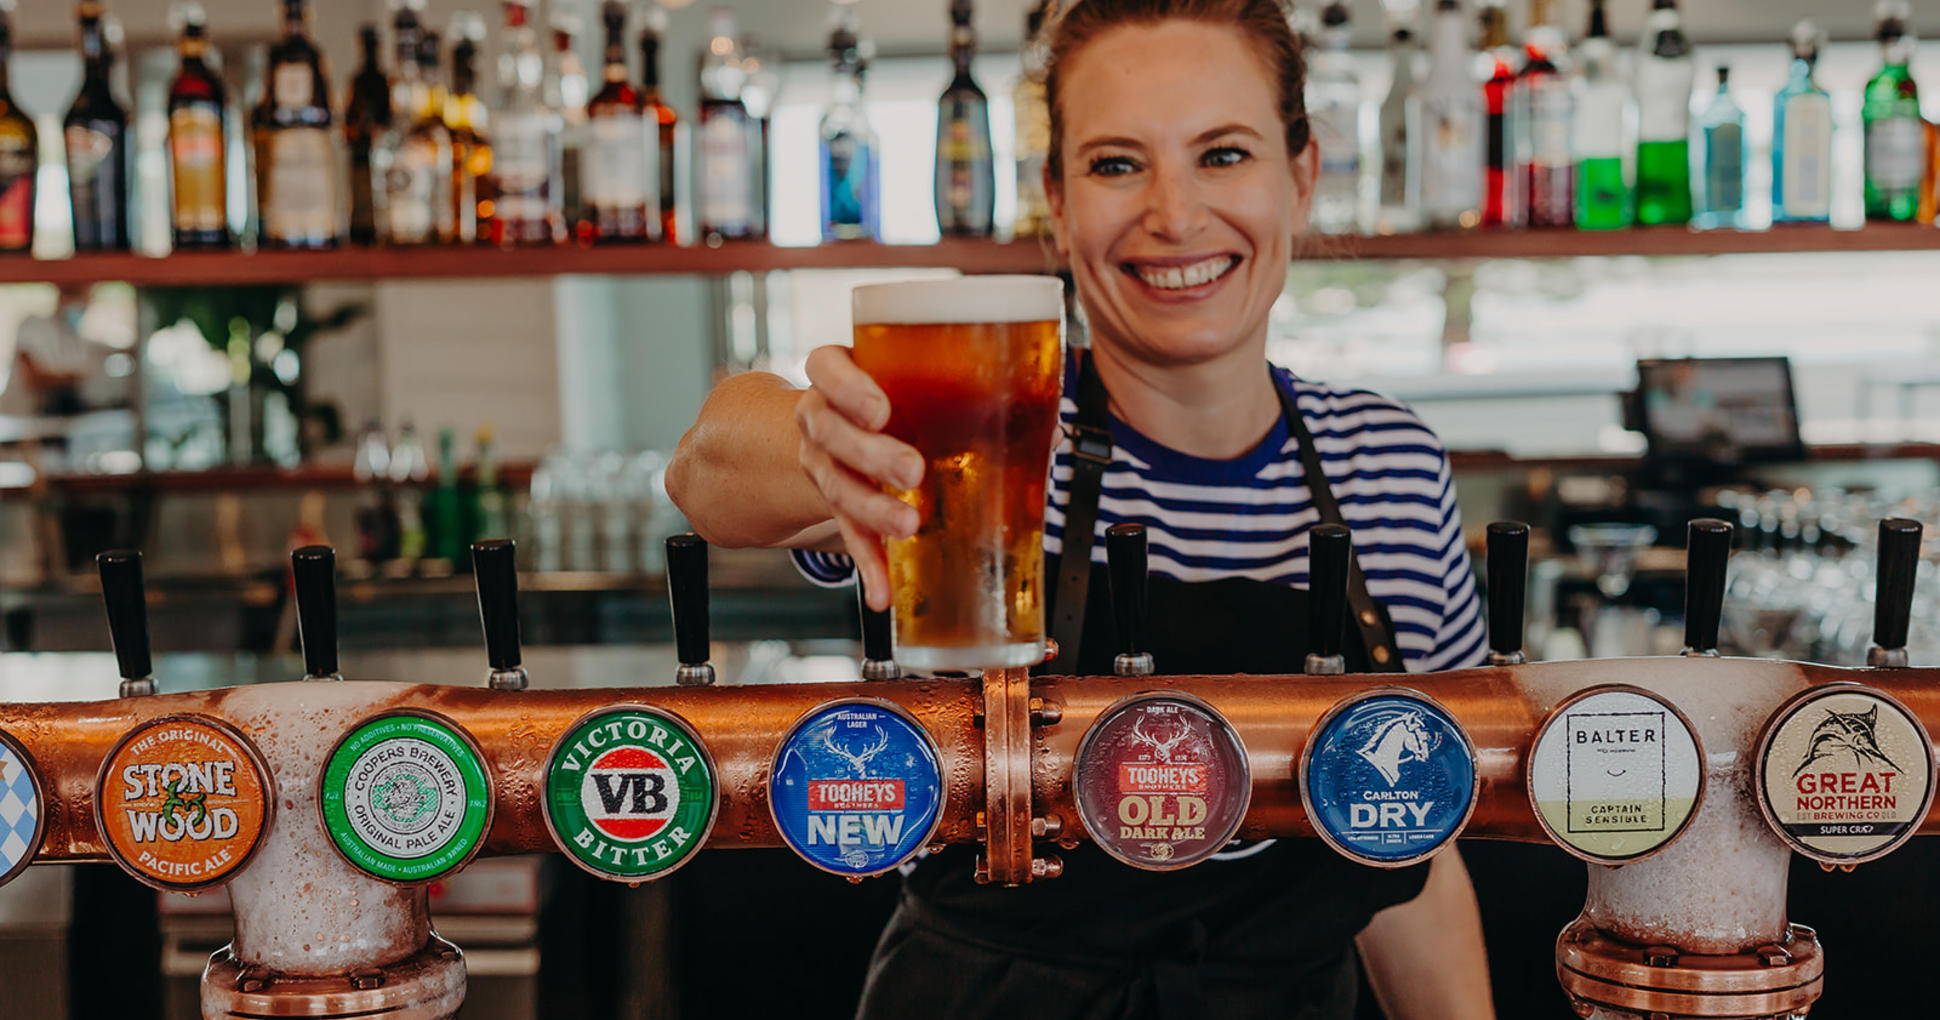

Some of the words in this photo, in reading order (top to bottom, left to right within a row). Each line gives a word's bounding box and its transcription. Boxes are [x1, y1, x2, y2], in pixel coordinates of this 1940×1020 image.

[837, 712, 878, 720] AUSTRALIAN
[1167, 705, 1179, 713] ALE
[130, 735, 156, 756] THE
[158, 729, 225, 754] ORIGINAL
[349, 740, 360, 752] NO
[360, 724, 396, 743] ADDITIVES
[561, 720, 697, 775] VICTORIA
[1575, 729, 1656, 744] BALTER
[122, 760, 237, 801] STONE
[354, 746, 405, 792] COOPERS
[409, 746, 458, 797] BREWERY
[1127, 767, 1199, 784] TOOHEYS
[1796, 772, 1897, 795] GREAT
[591, 773, 668, 815] VB
[817, 783, 896, 803] TOOHEYS
[1362, 790, 1419, 801] CARLTON
[1796, 795, 1897, 811] NORTHERN
[1117, 795, 1208, 827] OLD
[1350, 801, 1435, 828] DRY
[1591, 804, 1641, 814] CAPTAIN
[1813, 811, 1864, 820] BREWING
[126, 807, 239, 843] WOOD
[354, 804, 401, 849] ORIGINAL
[406, 830, 439, 850] PALE
[439, 809, 457, 835] ALE
[807, 814, 905, 846] NEW
[1119, 826, 1169, 840] DARK
[1170, 826, 1206, 840] ALE
[1820, 825, 1848, 834] SUPER
[340, 832, 377, 866] AUSTRALIAN
[376, 860, 396, 872] MADE
[402, 857, 447, 874] AUSTRALIAN
[573, 825, 692, 866] BITTER
[138, 850, 201, 876] PACIFIC
[205, 848, 232, 872] ALE
